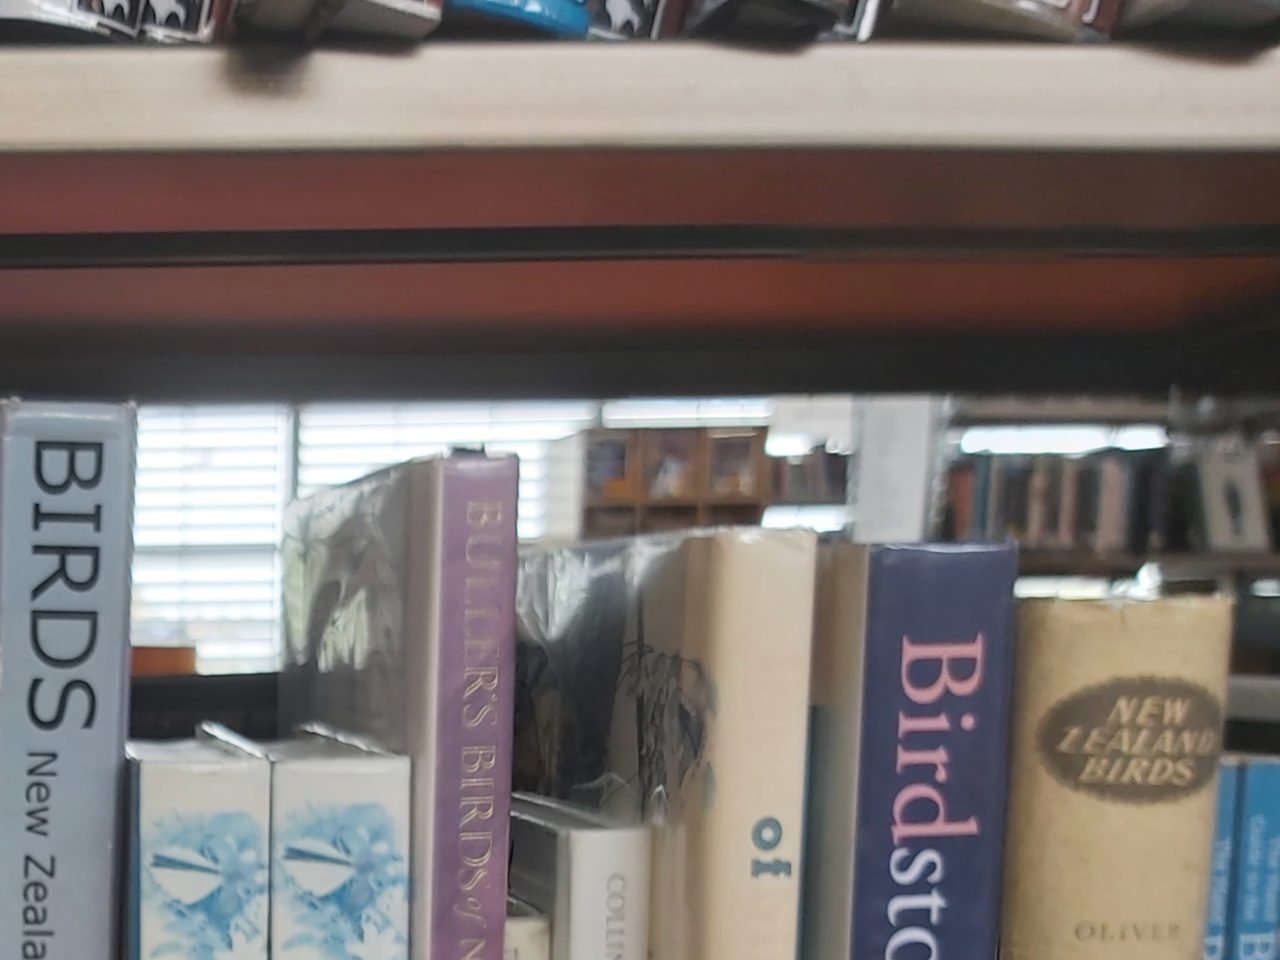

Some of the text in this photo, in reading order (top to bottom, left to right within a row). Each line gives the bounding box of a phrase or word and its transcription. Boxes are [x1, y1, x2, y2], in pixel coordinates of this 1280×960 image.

[26, 440, 104, 732] BIRDS
[1107, 695, 1192, 725] NEW
[1056, 725, 1215, 756] ZEALAND
[1078, 757, 1196, 786] BIRDS
[24, 751, 59, 838] New
[457, 744, 497, 893] BIRDS
[750, 815, 792, 878] of
[453, 896, 487, 930] of
[1074, 920, 1182, 942] OLIVER
